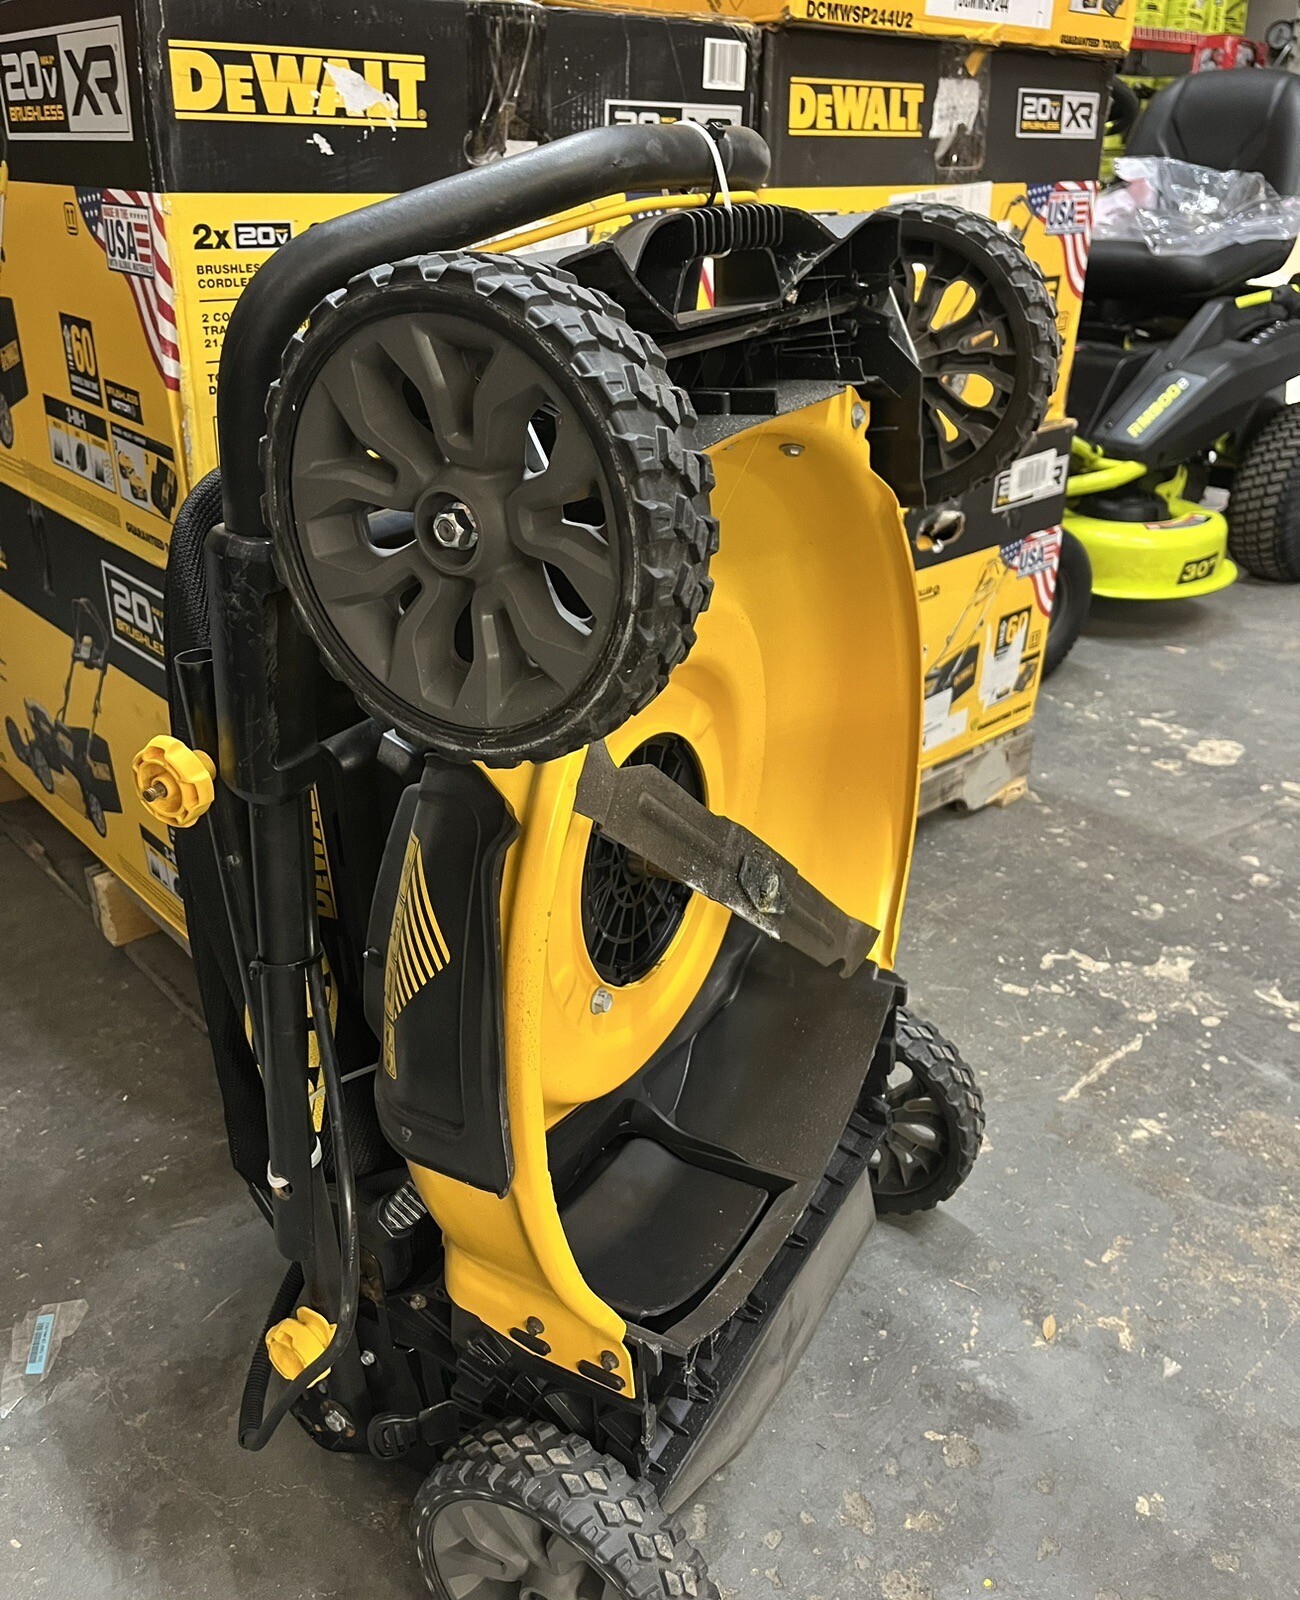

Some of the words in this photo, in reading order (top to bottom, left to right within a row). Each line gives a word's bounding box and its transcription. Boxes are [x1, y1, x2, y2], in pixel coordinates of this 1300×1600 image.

[807, 0, 914, 28] DCMWSP244U2
[64, 44, 123, 116] XR
[9, 104, 65, 121] BRUSHLESS
[1066, 102, 1091, 128] XR
[1048, 201, 1075, 226] USA
[105, 219, 138, 261] USA
[196, 263, 260, 275] BRUSHLES
[198, 278, 252, 289] CORDLE
[202, 314, 209, 323] 2
[70, 324, 96, 377] 60
